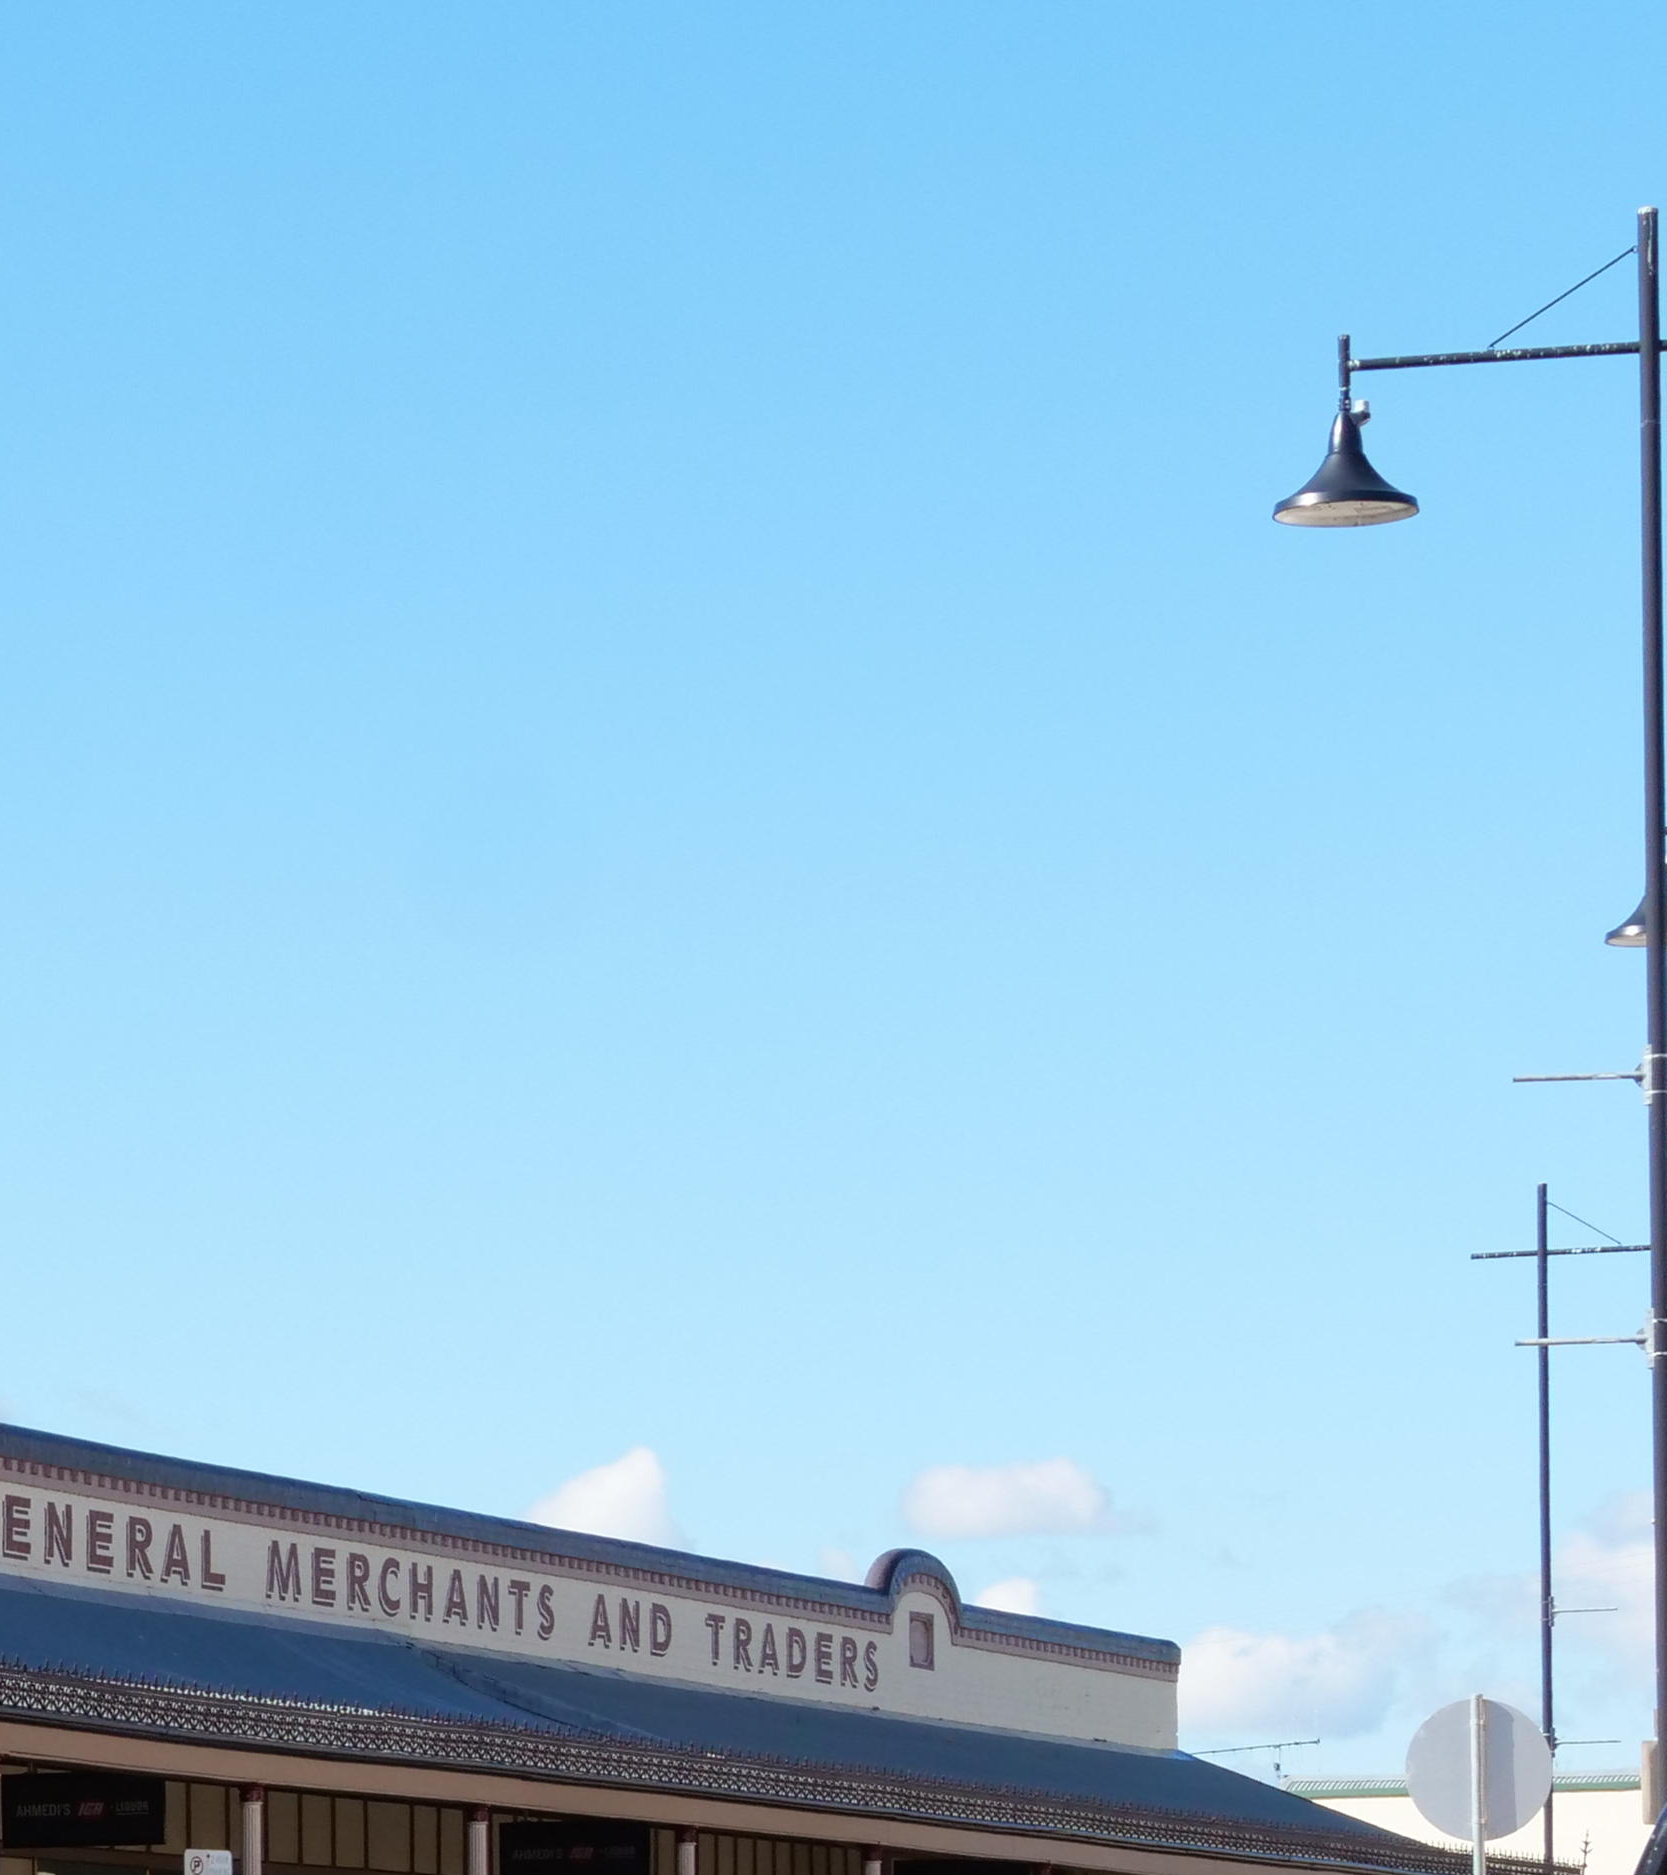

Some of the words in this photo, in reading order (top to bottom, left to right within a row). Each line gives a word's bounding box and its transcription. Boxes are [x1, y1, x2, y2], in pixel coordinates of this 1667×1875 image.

[265, 1540, 556, 1641] MERCHANTS
[587, 1593, 672, 1657] AND
[705, 1613, 879, 1692] TRADERS
